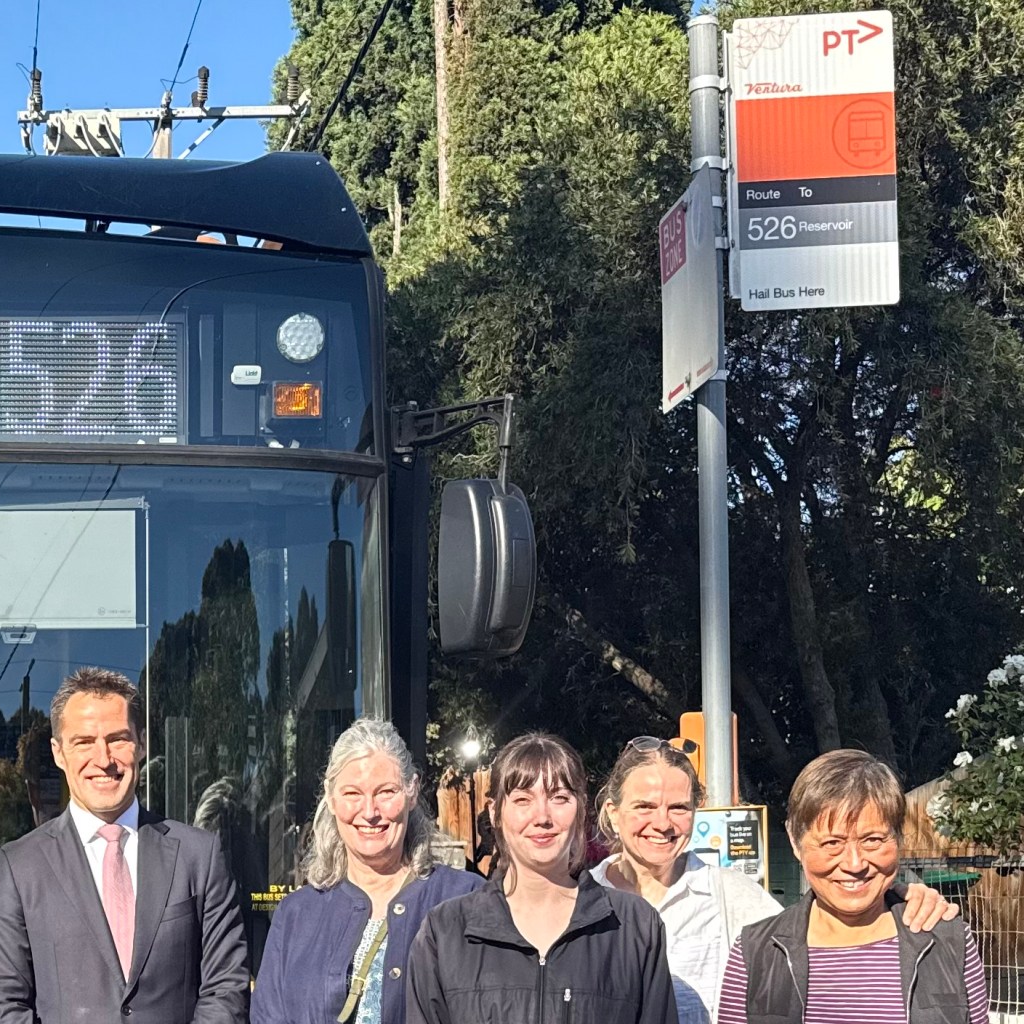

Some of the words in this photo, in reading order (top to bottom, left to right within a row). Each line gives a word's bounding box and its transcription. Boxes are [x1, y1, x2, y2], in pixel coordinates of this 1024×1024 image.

[745, 82, 803, 95] Ventura
[746, 189, 781, 200] Route
[798, 186, 813, 198] To
[663, 210, 682, 250] BUS
[747, 215, 796, 241] 526
[799, 219, 853, 232] Reservoir
[665, 239, 683, 277] ZONE
[749, 288, 770, 300] Hail
[773, 287, 795, 299] Bus
[799, 286, 825, 297] Here
[6, 322, 177, 436] 526
[251, 893, 262, 901] THIS
[263, 893, 274, 901] BUS
[275, 893, 287, 901] SET
[251, 903, 258, 911] AT
